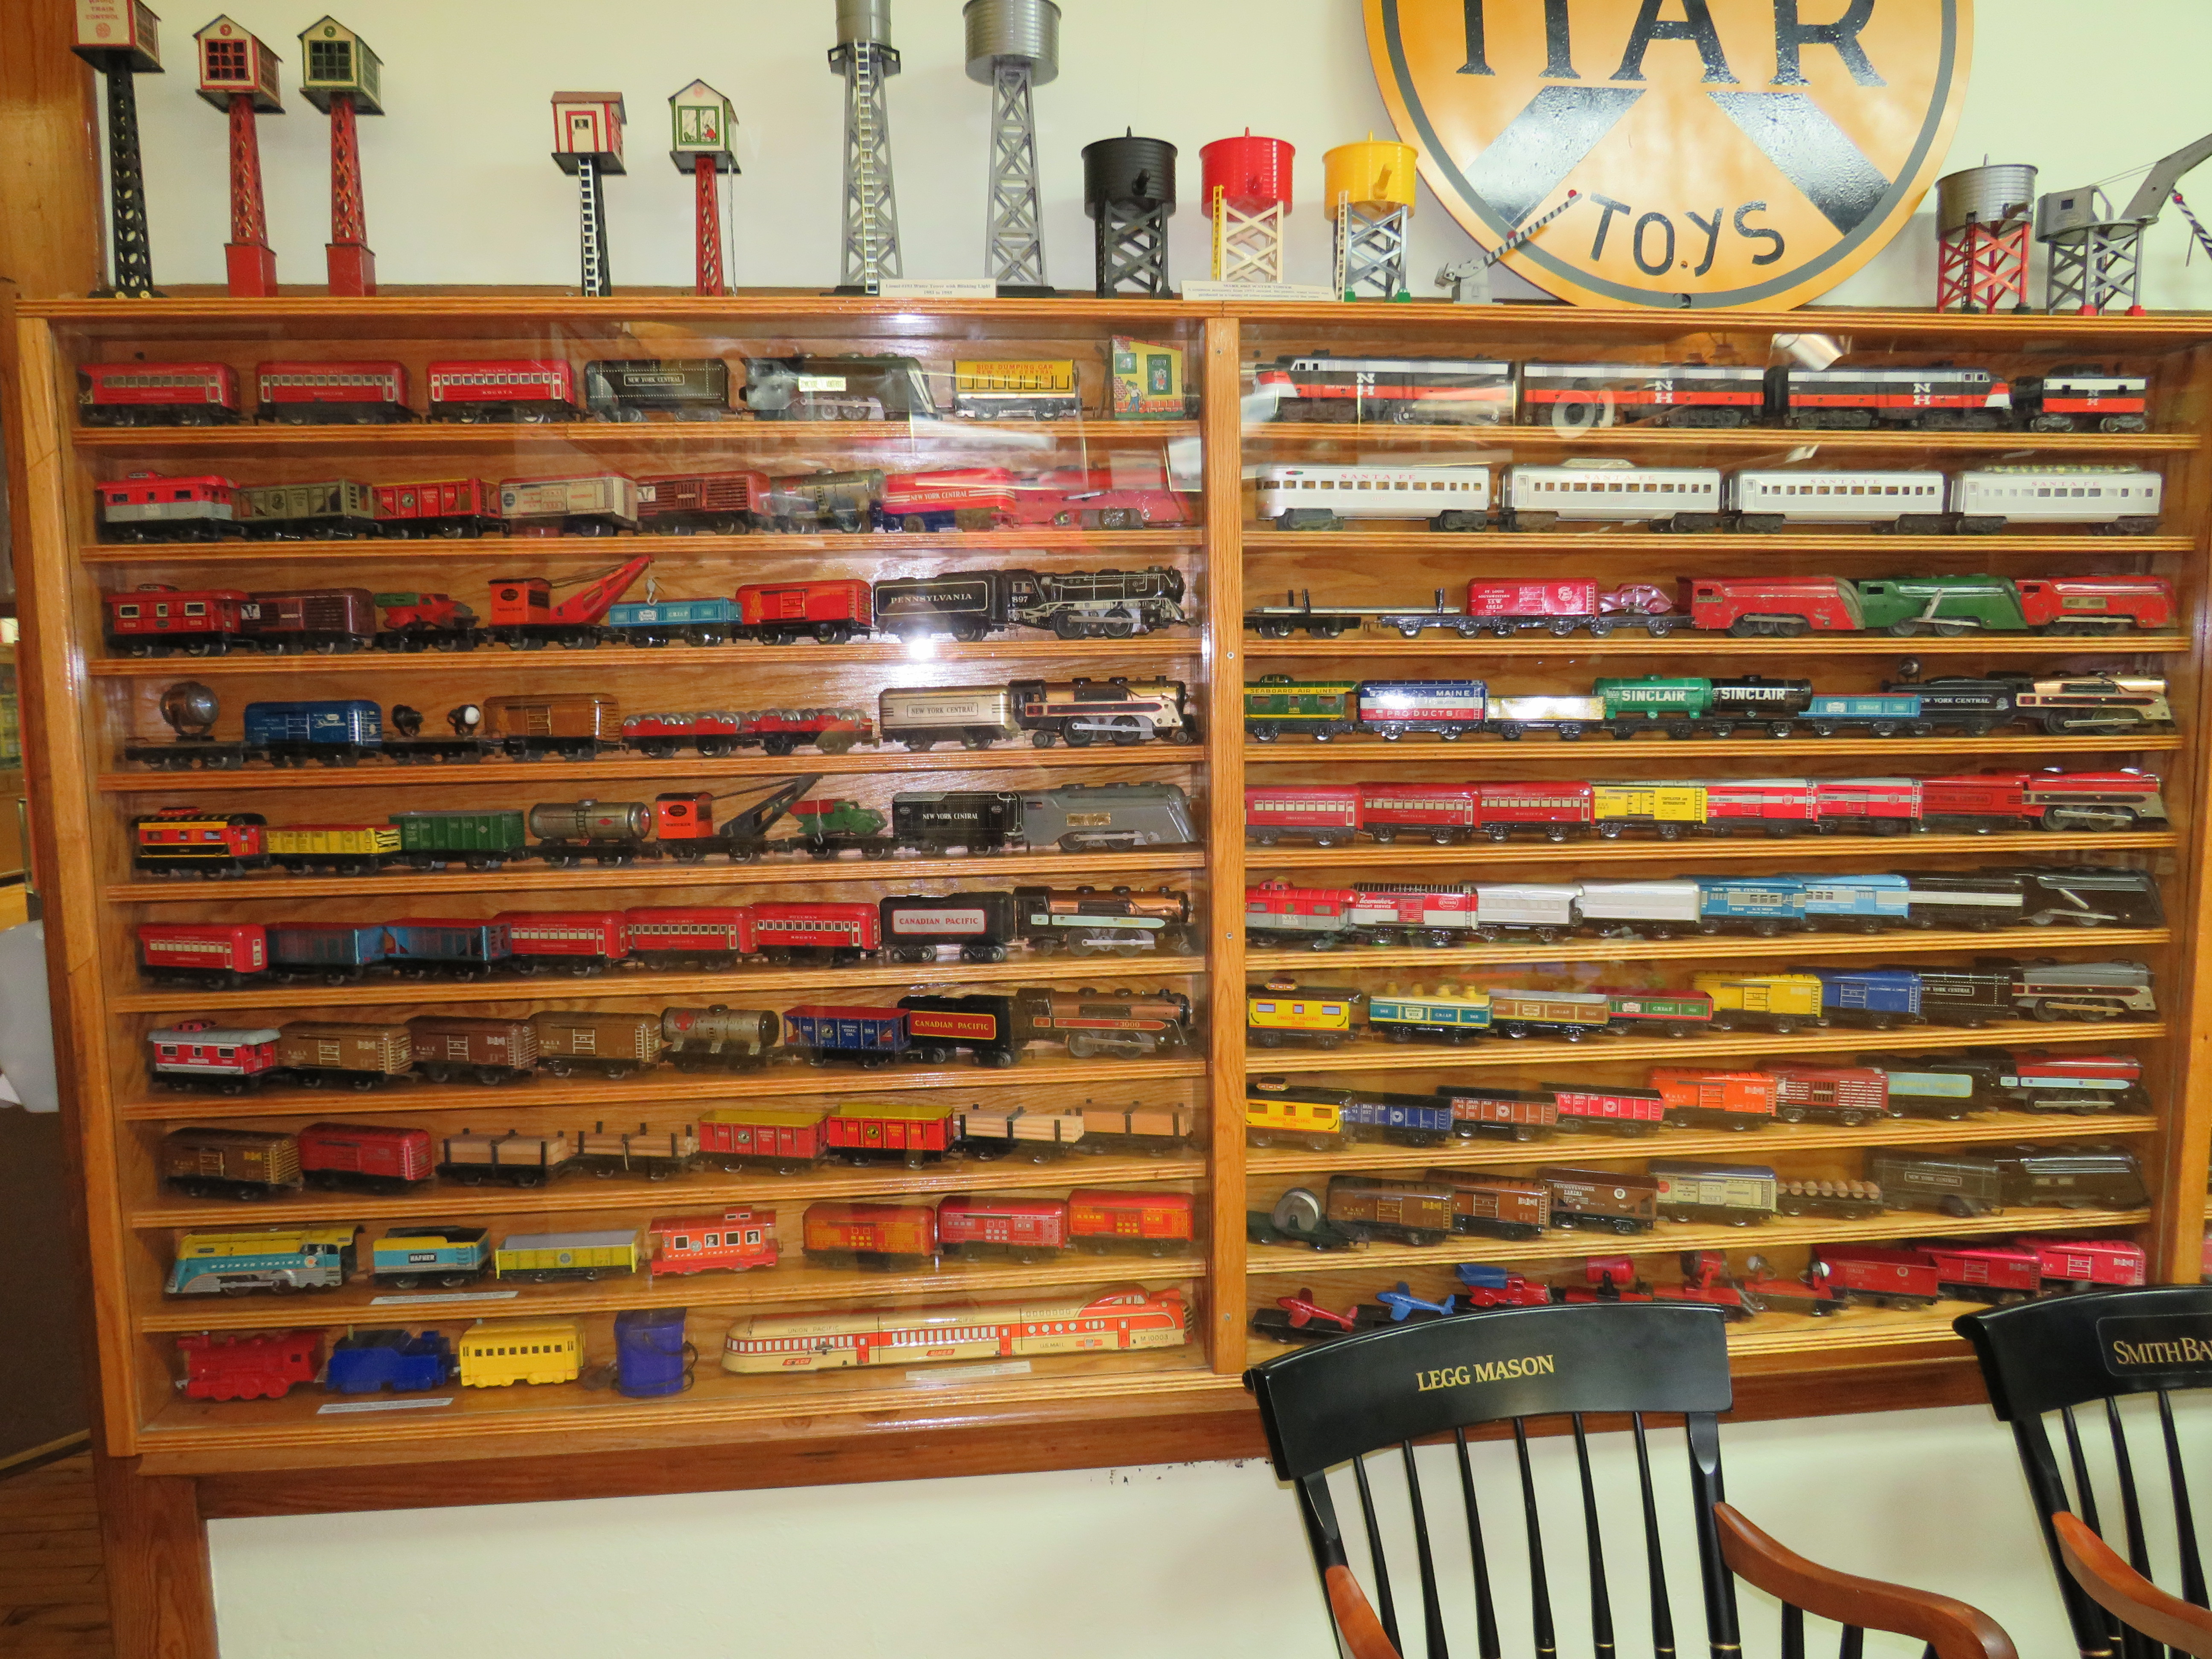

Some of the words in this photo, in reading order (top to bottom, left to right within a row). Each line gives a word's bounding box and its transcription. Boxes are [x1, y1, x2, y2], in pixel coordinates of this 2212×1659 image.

[1588, 192, 1784, 278] TOYS
[890, 594, 972, 604] PENNSYLVANIA
[1622, 690, 1686, 701] SINCLAIR
[1721, 688, 1786, 700] SINCLAIR
[1358, 894, 1395, 905] Pacemaker
[914, 1020, 953, 1028] CANADIAN
[958, 1022, 988, 1030] PACIFIC
[1553, 1182, 1595, 1192] PENNSYLVANIA
[812, 1325, 840, 1333] PACIFIC
[2179, 1337, 2212, 1362] BA
[1415, 1366, 1471, 1391] LEGG
[1473, 1354, 1555, 1383] MASON
